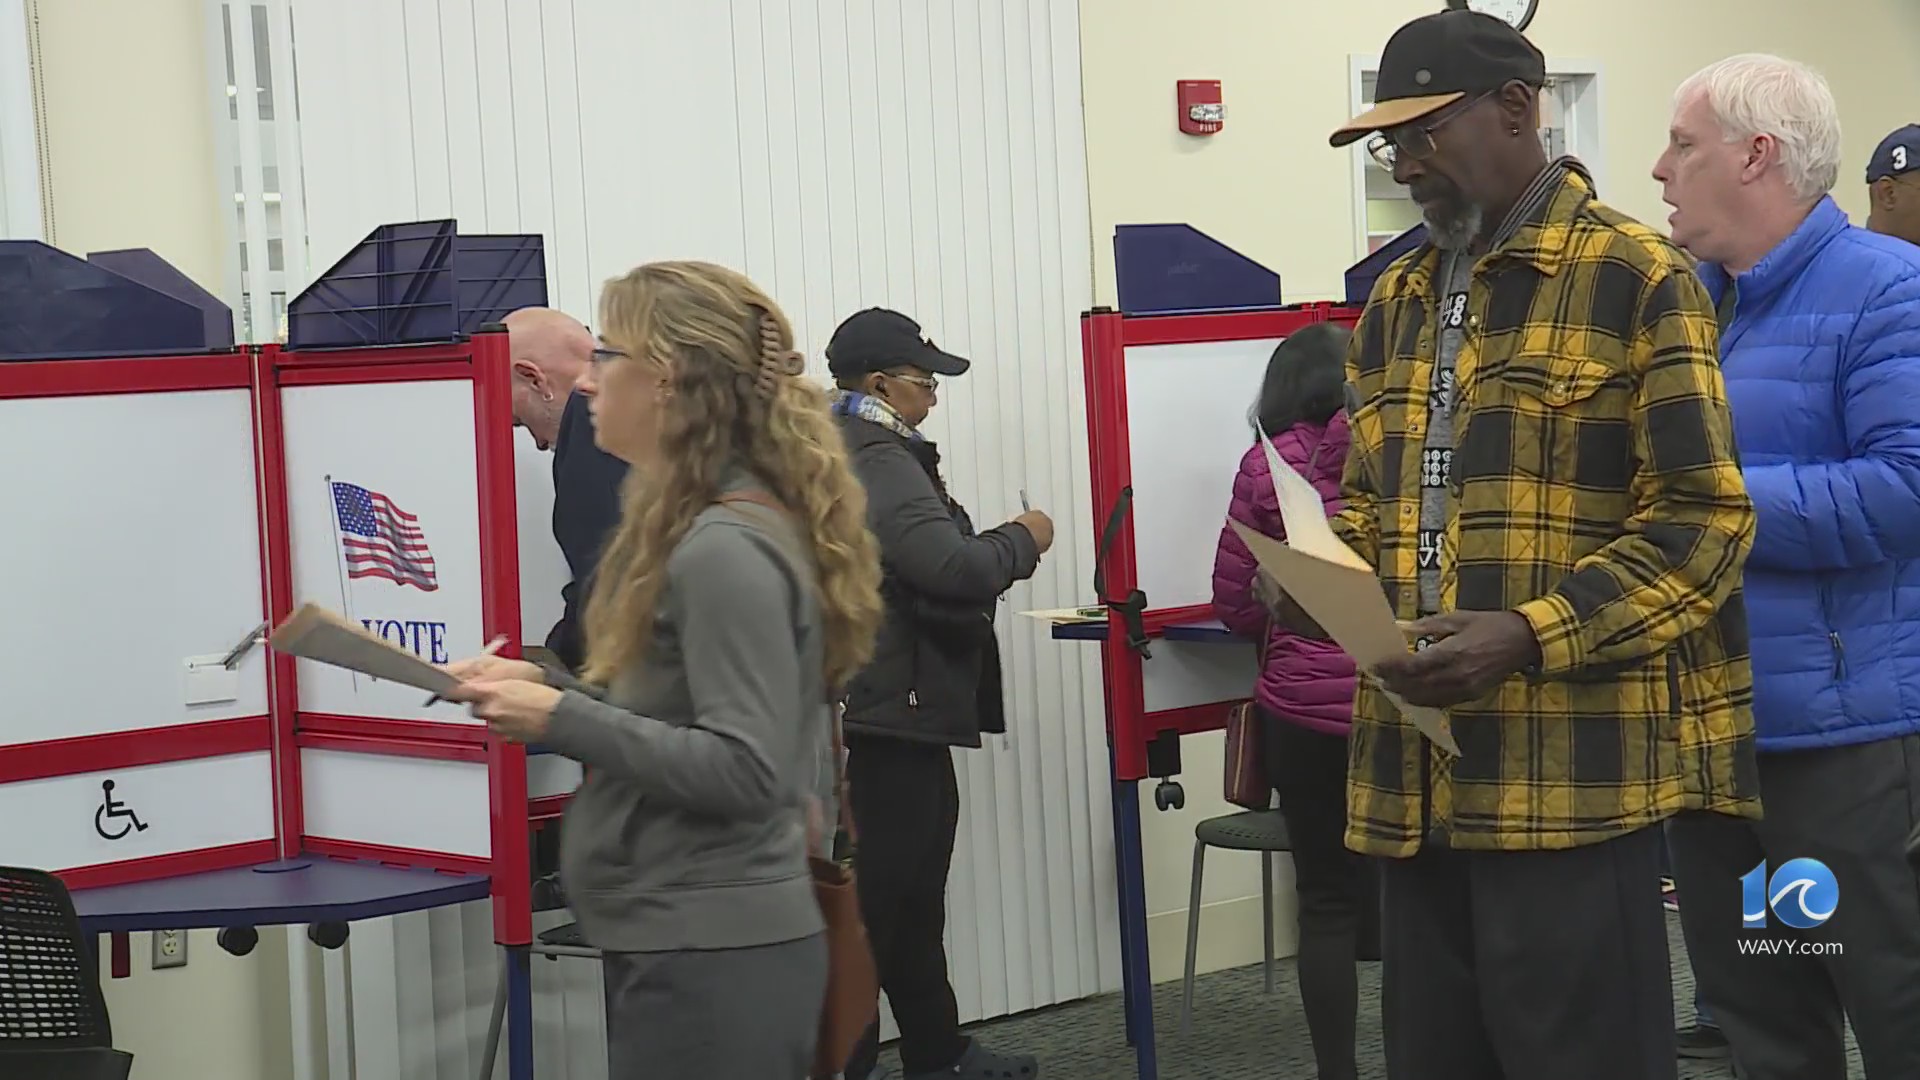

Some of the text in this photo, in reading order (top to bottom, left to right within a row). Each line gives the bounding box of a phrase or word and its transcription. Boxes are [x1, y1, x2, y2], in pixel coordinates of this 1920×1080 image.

[1506, 10, 1514, 23] 5
[1199, 123, 1217, 132] FIRE
[1892, 145, 1907, 170] 3
